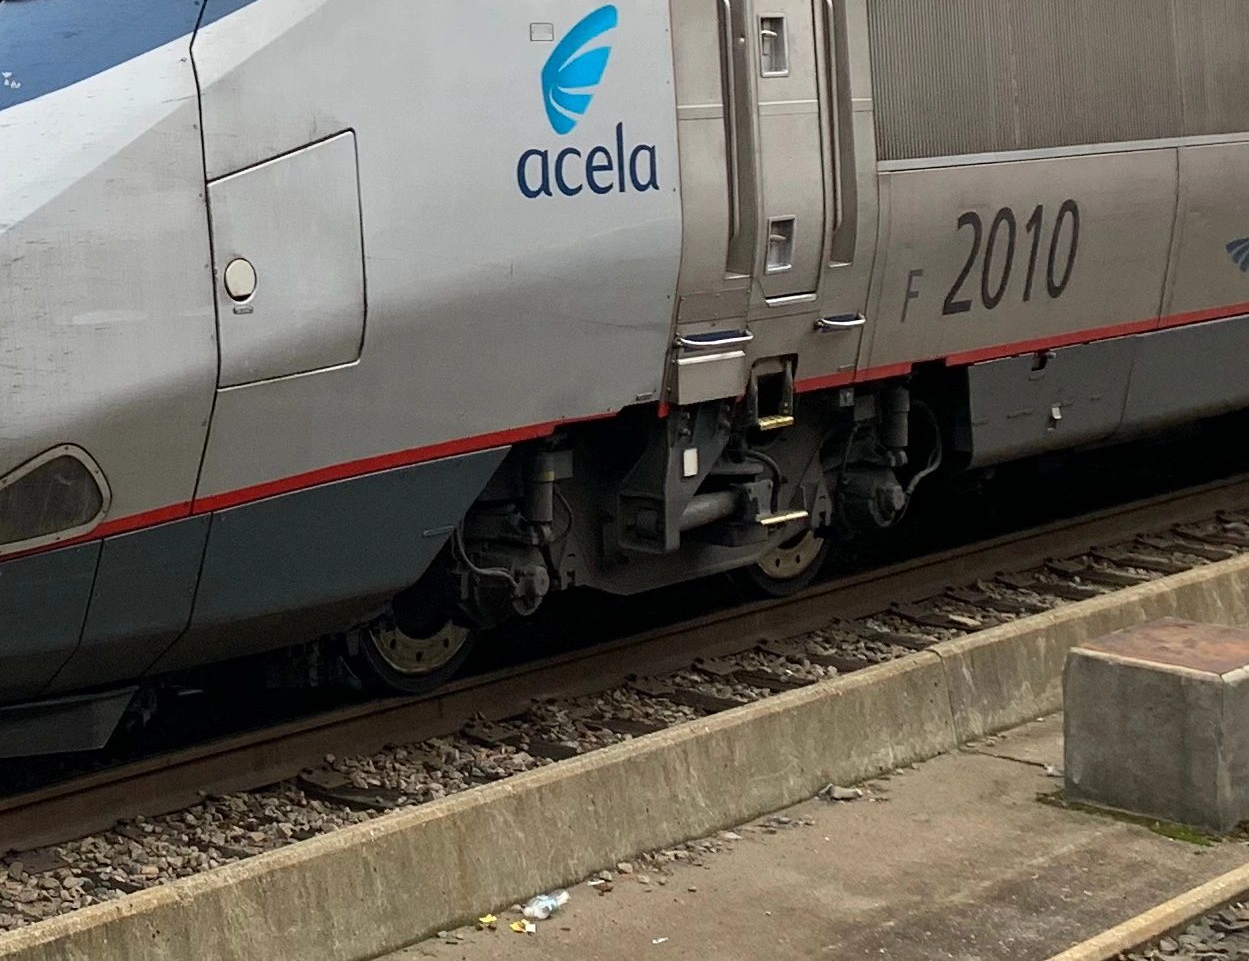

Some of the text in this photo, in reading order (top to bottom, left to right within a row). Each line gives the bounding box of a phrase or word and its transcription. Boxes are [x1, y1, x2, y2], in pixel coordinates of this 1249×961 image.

[516, 121, 660, 199] acela
[901, 198, 1080, 323] F 2010
